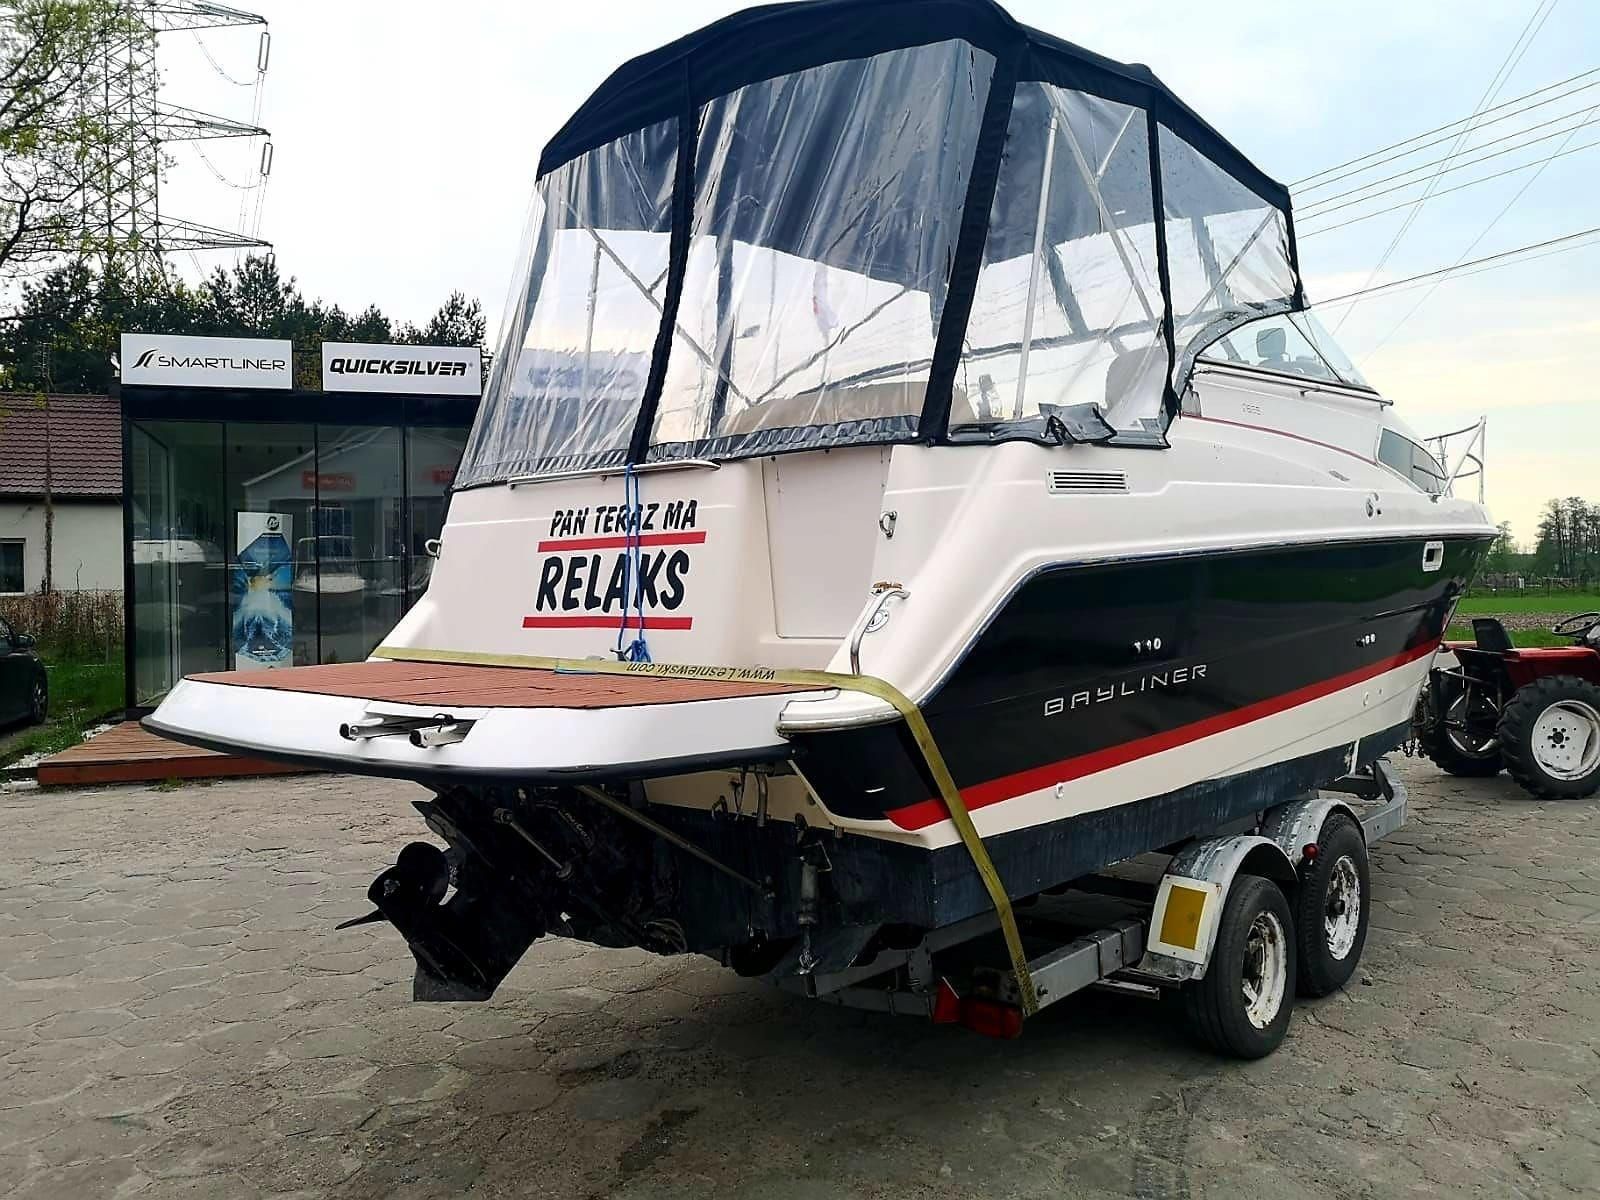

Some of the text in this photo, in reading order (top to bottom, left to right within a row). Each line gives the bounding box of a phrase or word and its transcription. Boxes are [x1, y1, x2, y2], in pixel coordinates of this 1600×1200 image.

[158, 355, 286, 371] SMARTLINER
[329, 358, 467, 377] QUICKSILVER
[550, 499, 698, 537] PAN TERAZ MA
[535, 549, 689, 613] RELAKS
[1044, 664, 1207, 716] BAYLINER
